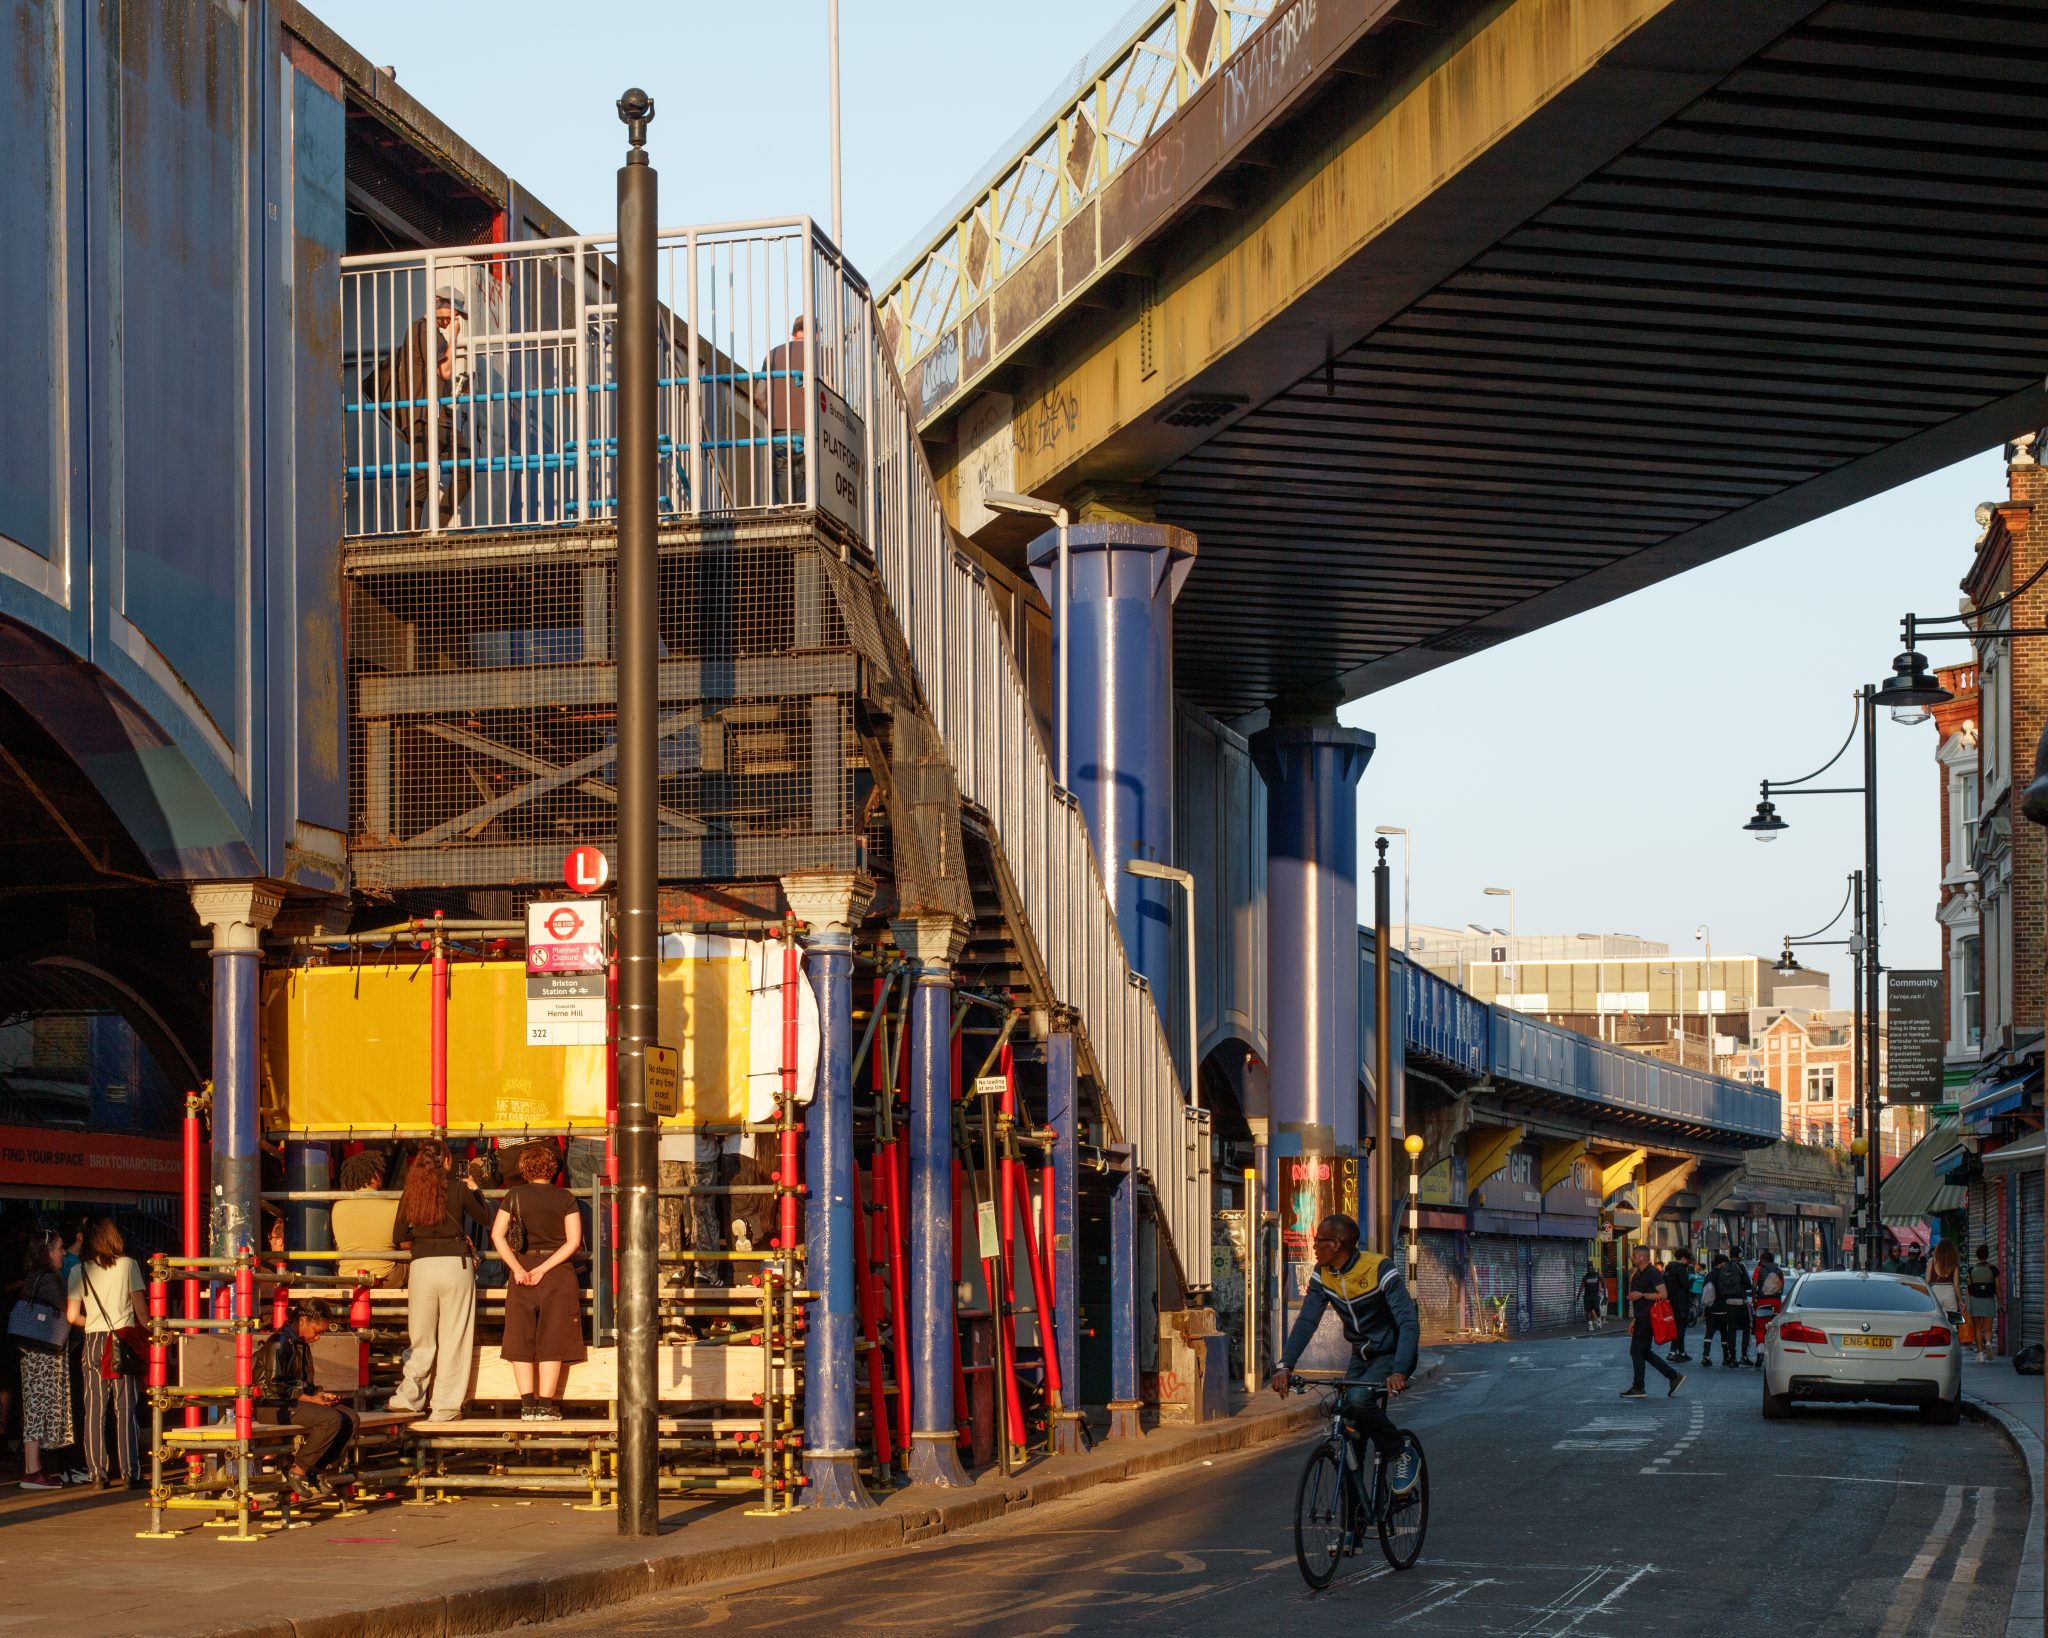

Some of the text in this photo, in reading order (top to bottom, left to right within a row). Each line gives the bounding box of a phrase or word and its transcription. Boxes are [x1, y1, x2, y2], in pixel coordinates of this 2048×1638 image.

[824, 428, 861, 476] PLATFORM
[835, 472, 857, 510] OPEN
[577, 853, 596, 884] L
[1494, 948, 1501, 961] 1
[1890, 979, 1937, 988] Community
[532, 1030, 547, 1038] 322
[649, 1064, 675, 1077] No stopping
[664, 1079, 674, 1088] time
[655, 1091, 669, 1100] except
[2, 1147, 24, 1162] FIND
[27, 1150, 53, 1164] YOUR
[54, 1151, 84, 1166] SPACE
[1511, 1153, 1533, 1184] GIFT
[1843, 1337, 1892, 1347] EN64 CDO
